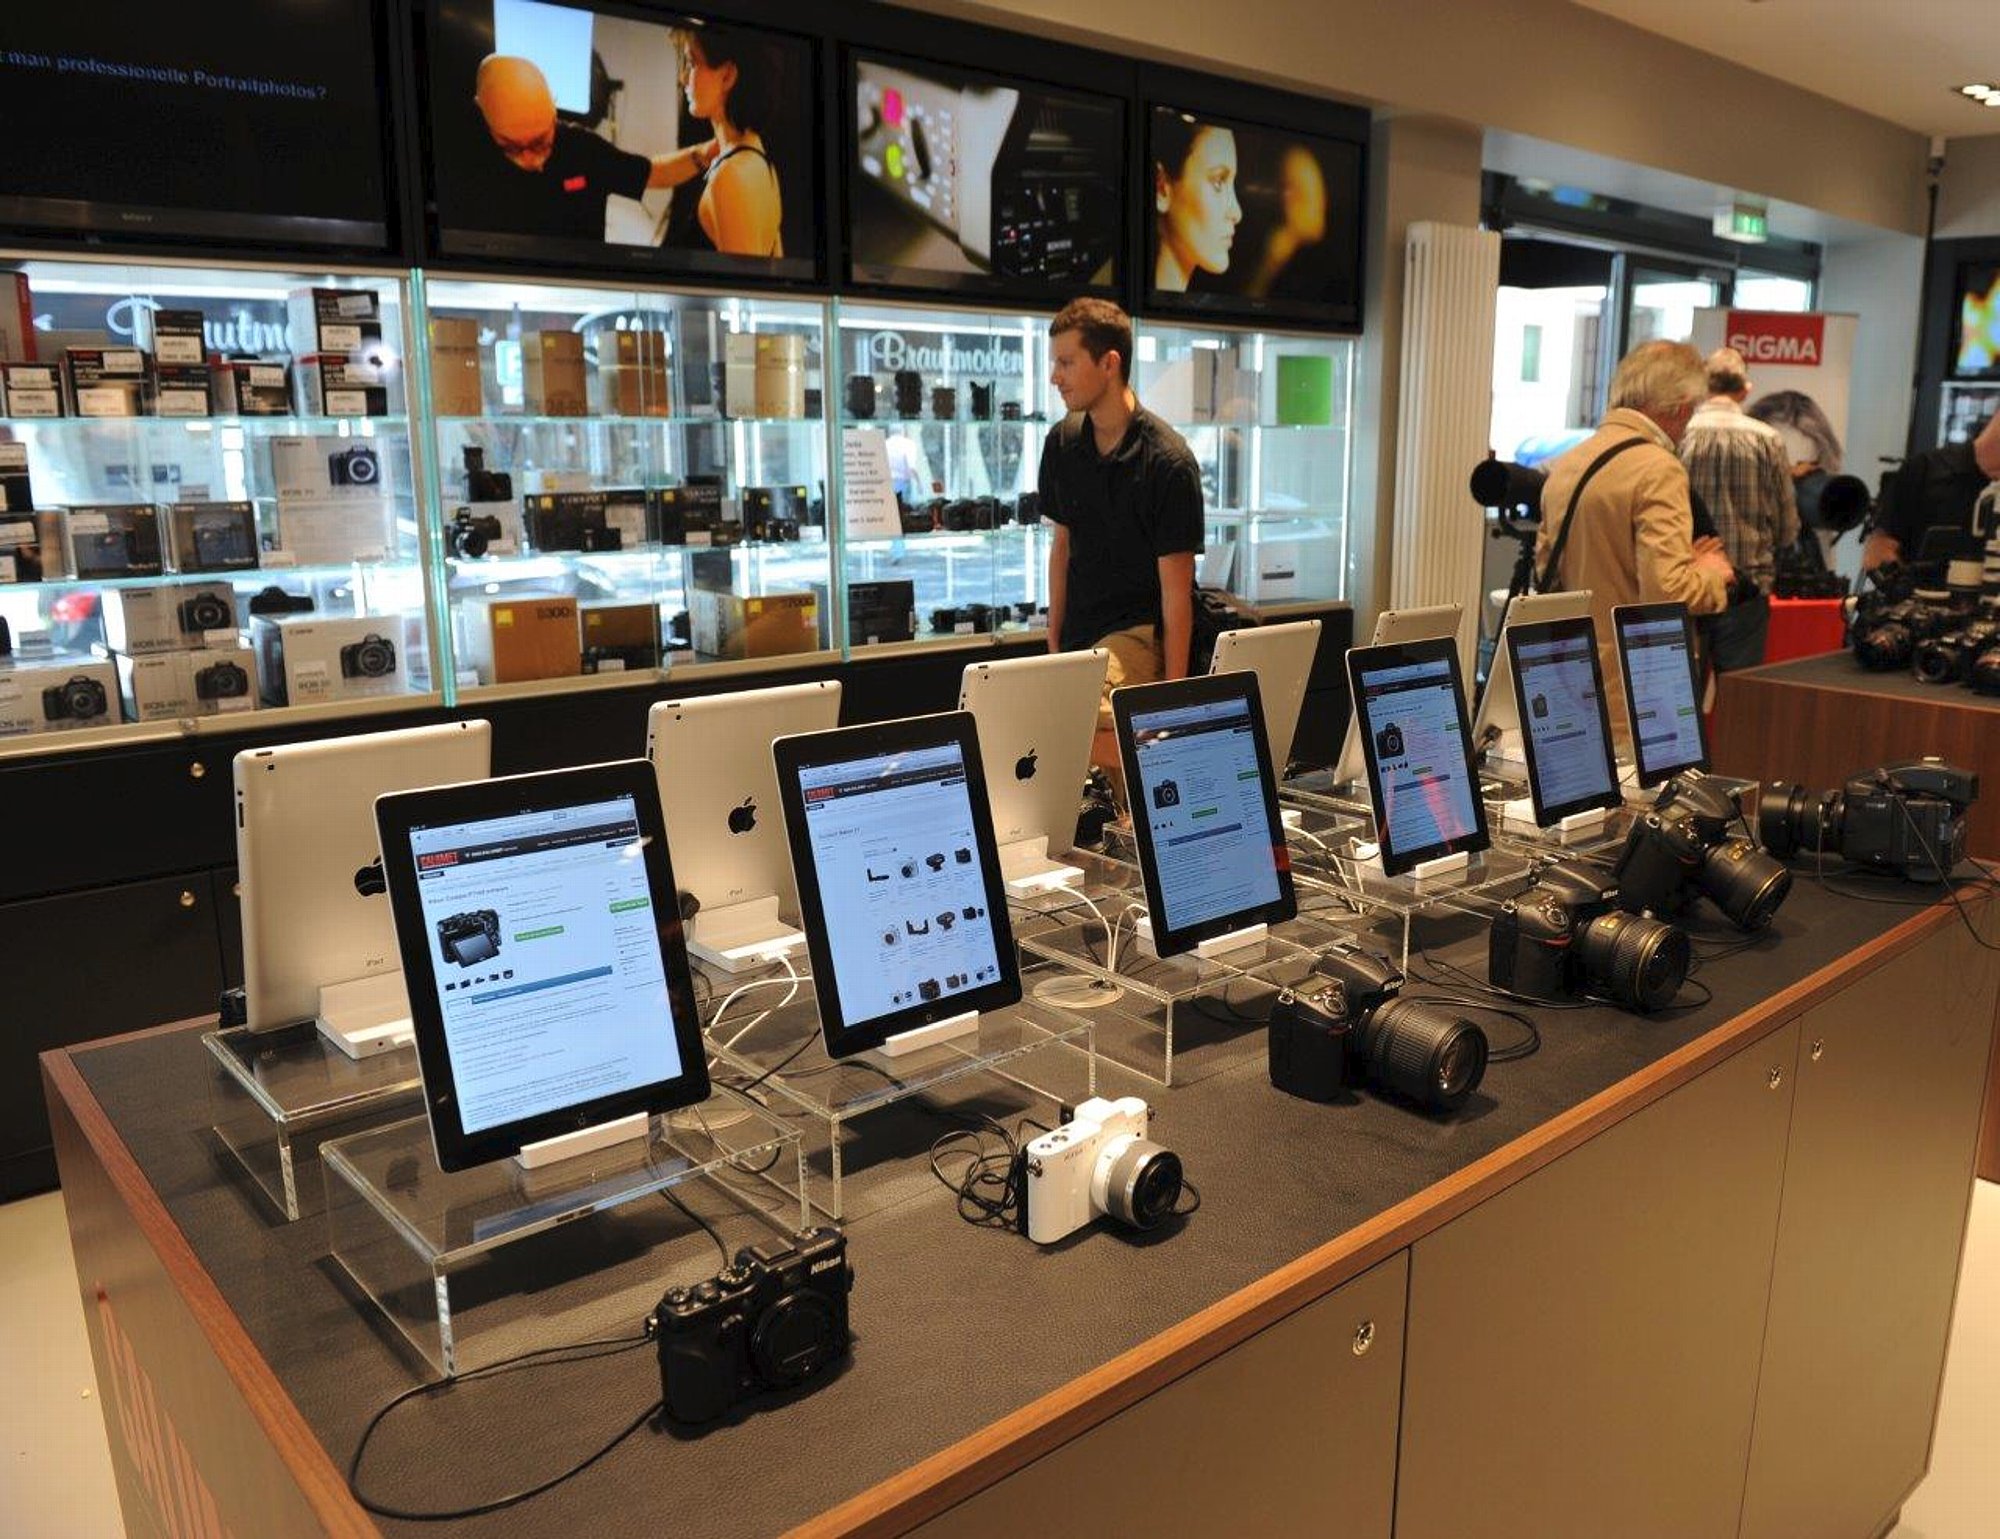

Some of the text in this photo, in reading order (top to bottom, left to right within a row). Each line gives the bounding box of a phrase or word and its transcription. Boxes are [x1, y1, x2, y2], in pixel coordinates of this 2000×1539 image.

[8, 50, 51, 68] man
[57, 57, 188, 85] professionelle
[192, 69, 327, 99] Portraitphotos?
[1730, 334, 1818, 362] SIGMA
[810, 1255, 842, 1276] Nikon
